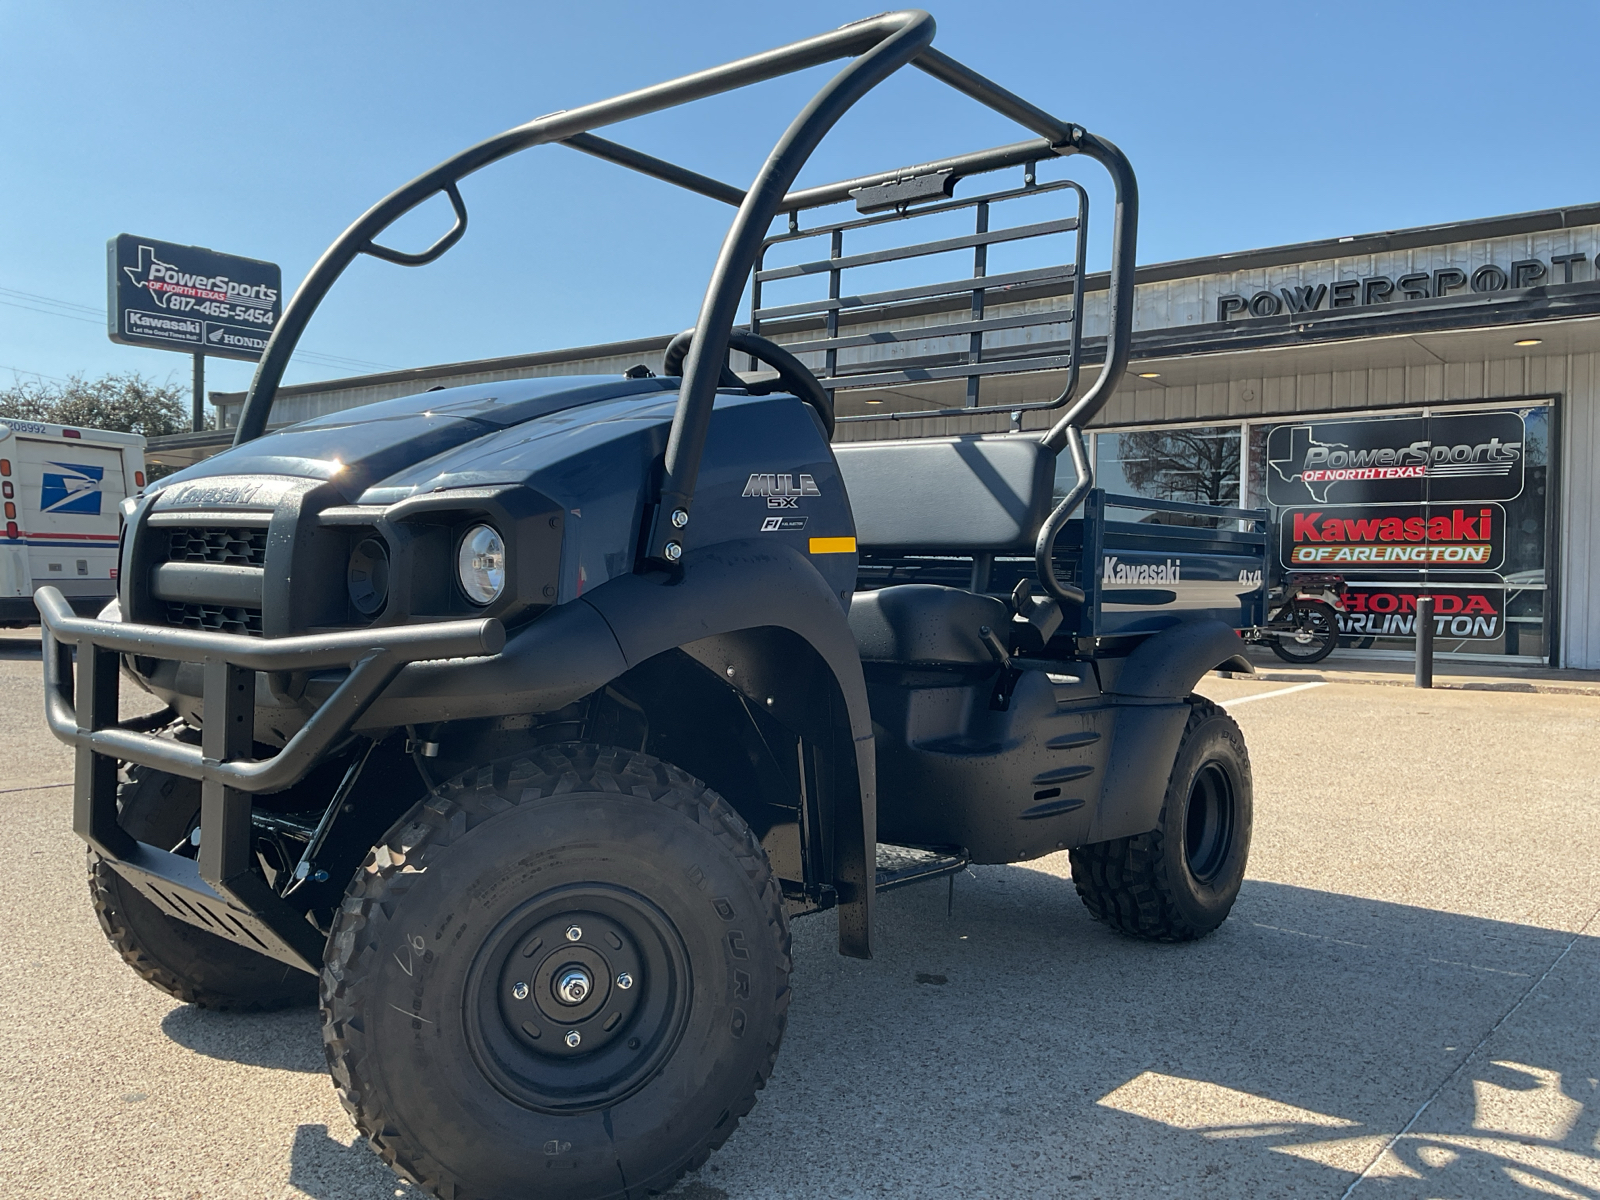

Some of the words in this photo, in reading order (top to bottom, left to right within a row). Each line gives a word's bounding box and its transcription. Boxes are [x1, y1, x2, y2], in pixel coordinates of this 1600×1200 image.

[148, 264, 278, 302] PowerSports
[149, 281, 162, 290] OF
[163, 283, 195, 297] NORTH
[196, 289, 225, 301] TEXAS
[1217, 252, 1600, 322] POWERSPORT
[169, 295, 274, 325] 817-465-5454
[129, 312, 200, 334] Kawasaki
[153, 329, 169, 337] Good
[1303, 437, 1521, 471] PowerSports
[742, 473, 821, 497] MULE
[1303, 469, 1324, 482] OF
[1325, 467, 1376, 481] NORTH
[1377, 466, 1425, 478] TEXAS
[767, 496, 799, 509] SX
[1293, 508, 1492, 542] Kawasaki
[1298, 547, 1331, 562] OF
[1333, 546, 1484, 562] ARLINGTON
[1103, 556, 1181, 585] Kawasaki
[1238, 569, 1262, 586] 4x4
[1335, 613, 1498, 637] ARLINTON
[710, 896, 752, 1040] DURO
